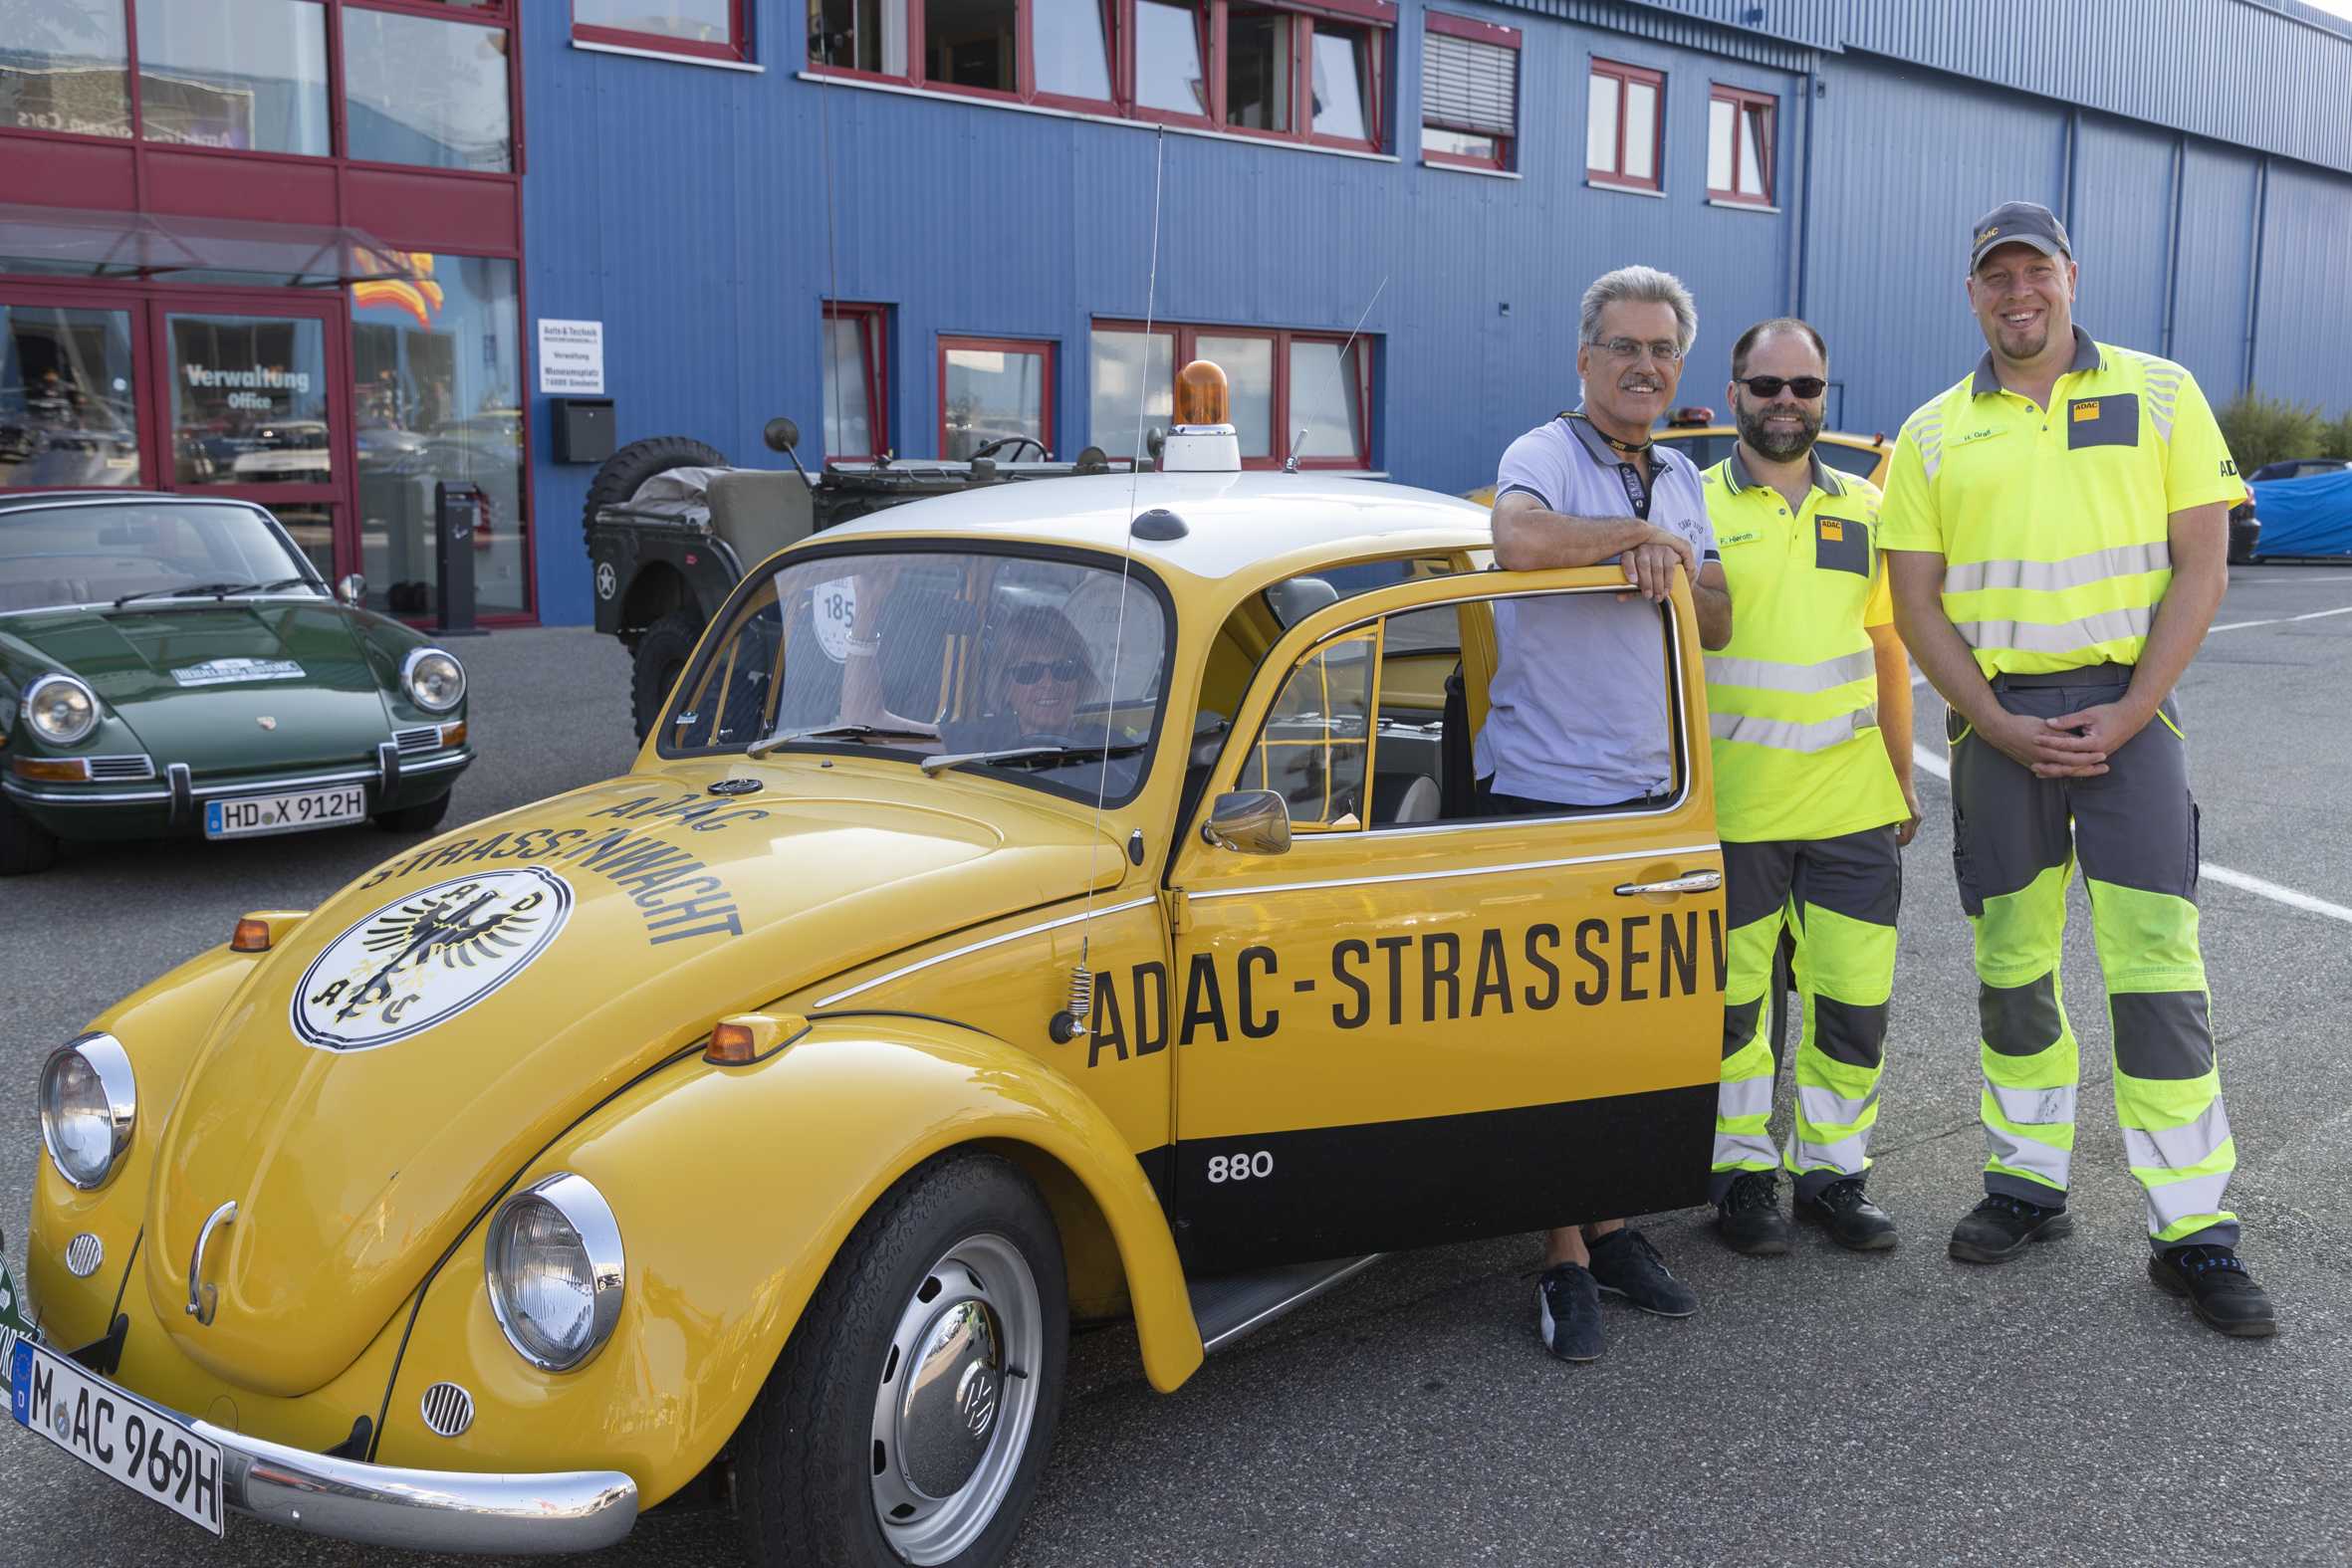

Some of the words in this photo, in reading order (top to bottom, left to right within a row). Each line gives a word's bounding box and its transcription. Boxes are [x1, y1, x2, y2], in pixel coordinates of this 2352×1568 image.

[1977, 227, 1999, 248] ADAC
[544, 326, 561, 336] Auto
[569, 327, 597, 336] Technik
[185, 363, 310, 393] Verwaltung
[227, 391, 272, 409] Office
[2075, 402, 2098, 411] ADAC
[1610, 440, 1626, 450] ADAC
[824, 593, 854, 628] 185
[225, 803, 259, 828] HD
[276, 799, 291, 823] X
[298, 790, 361, 820] 912H
[586, 793, 770, 831] ADAC
[1208, 1151, 1274, 1183] 880
[18, 1390, 25, 1409] D
[32, 1359, 54, 1430] M
[73, 1387, 115, 1464] AC
[125, 1415, 217, 1525] 969H
